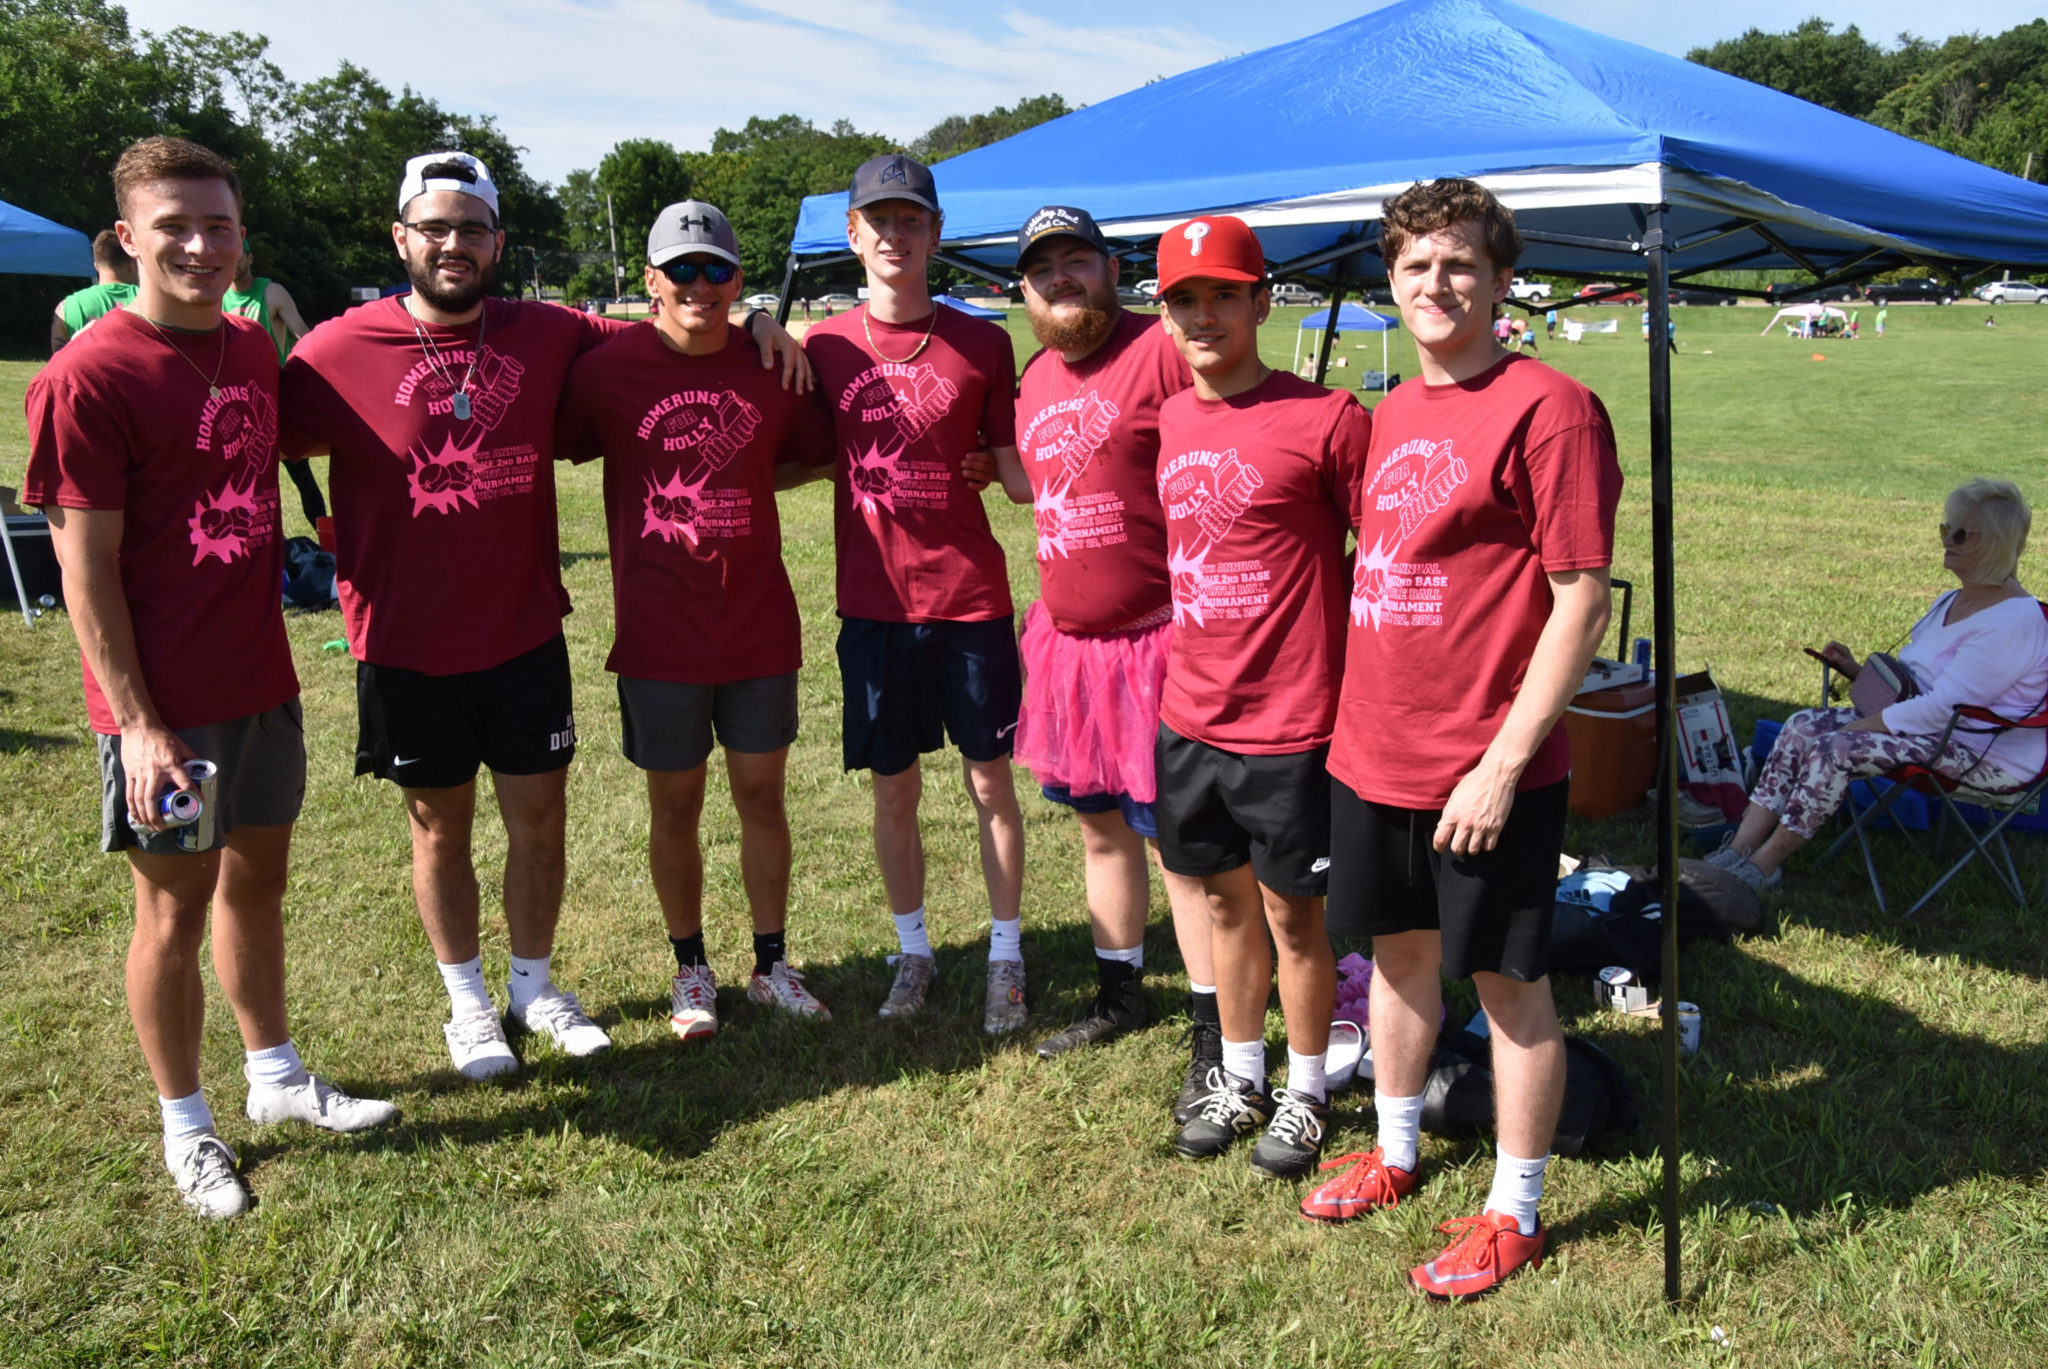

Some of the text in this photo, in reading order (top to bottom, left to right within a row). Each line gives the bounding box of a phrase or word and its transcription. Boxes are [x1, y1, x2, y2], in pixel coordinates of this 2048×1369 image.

[839, 363, 918, 412] HOMERUNS
[637, 390, 720, 441] HOMERUNS
[664, 409, 698, 434] FOR
[861, 389, 909, 422] HOLLY
[664, 416, 713, 451] HOLLY
[1020, 398, 1085, 453] HOMERUNS
[1037, 418, 1065, 444] FOR
[1035, 423, 1076, 462] HOLLY
[1167, 471, 1196, 501] FOR
[1376, 471, 1418, 511] HOLLY
[1383, 461, 1410, 491] FOR
[1168, 480, 1209, 520] HOLLY
[1240, 570, 1271, 583] BASE
[1415, 576, 1448, 587] BASE
[1409, 588, 1442, 600] BALL
